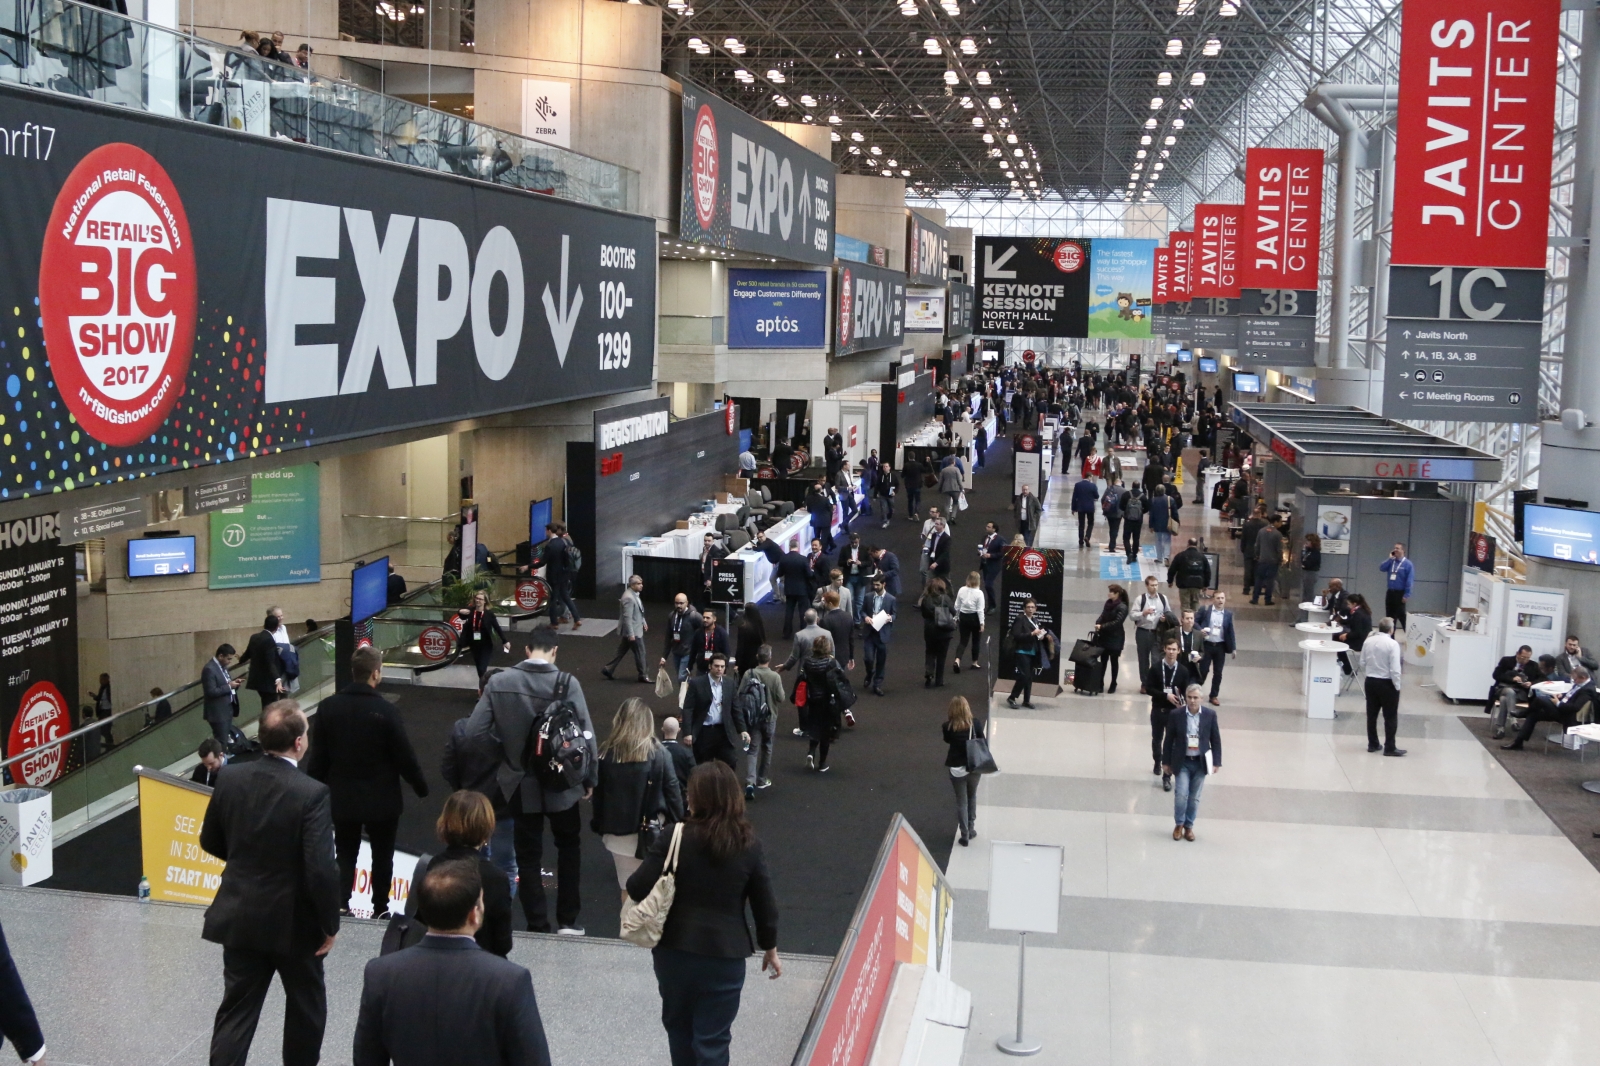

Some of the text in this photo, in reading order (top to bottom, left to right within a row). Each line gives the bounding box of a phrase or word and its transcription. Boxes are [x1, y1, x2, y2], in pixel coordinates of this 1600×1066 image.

[535, 127, 557, 135] ZEBRA
[1422, 19, 1475, 225] JAVITS
[1487, 20, 1531, 230] CENTER
[731, 132, 794, 241] EXPO
[62, 168, 182, 249] National Retail Federation
[1255, 167, 1282, 270] JAVITS
[1288, 167, 1310, 271] CENTER
[86, 220, 163, 244] RETAIL'S
[600, 244, 636, 271] BOOTHS
[920, 229, 937, 277] EXPO
[1061, 252, 1080, 260] BIG
[1120, 259, 1147, 267] shopper
[1201, 216, 1218, 285] JAVITS
[1222, 216, 1236, 286] CENTER
[1157, 255, 1168, 296] JAVITS
[1174, 240, 1187, 292] JAVITS
[73, 247, 177, 318] BIG
[734, 289, 821, 300] Engage Customers Differently
[983, 284, 1064, 297] KEYNOTE
[1429, 266, 1507, 320] 1C
[265, 197, 525, 403] EXPO
[599, 281, 633, 319] 100-
[854, 278, 883, 338] EXPO
[982, 298, 1056, 311] SESSION
[1205, 298, 1229, 315] 1B
[1259, 290, 1298, 316] 3B
[982, 311, 1053, 322] NORTH HALL,
[982, 321, 1024, 330] LEVEL 2
[79, 322, 169, 357] SHOW
[1415, 331, 1468, 340] Javits North
[598, 332, 632, 371] 1299
[1415, 351, 1428, 360] 1A,
[1431, 352, 1445, 361] 1B,
[1447, 352, 1461, 361] 3A,
[103, 366, 149, 386] 2017
[78, 374, 172, 424] nrfBIGshow.com
[1412, 392, 1495, 402] 1C Meeting Rooms
[601, 411, 668, 450] REGISTRATION
[283, 471, 295, 480] up.
[1375, 461, 1431, 478] CAFÉ
[98, 505, 126, 517] Crystal Palace
[96, 521, 111, 532] Special
[111, 520, 124, 528] Events
[0, 557, 64, 581] SUNDAY, JANUARY 15
[1025, 559, 1042, 567] BIG
[0, 587, 67, 614] MONDAY, JANUARY 16
[1, 618, 69, 646] TUESDAY, JANUARY 17
[24, 708, 55, 728] RETAIL'S
[24, 748, 59, 777] SHOW
[34, 769, 52, 786] 2017
[22, 810, 47, 850] JAVITS
[174, 815, 196, 834] SEE
[171, 840, 182, 857] IN
[185, 843, 199, 860] 30
[166, 865, 202, 887] START
